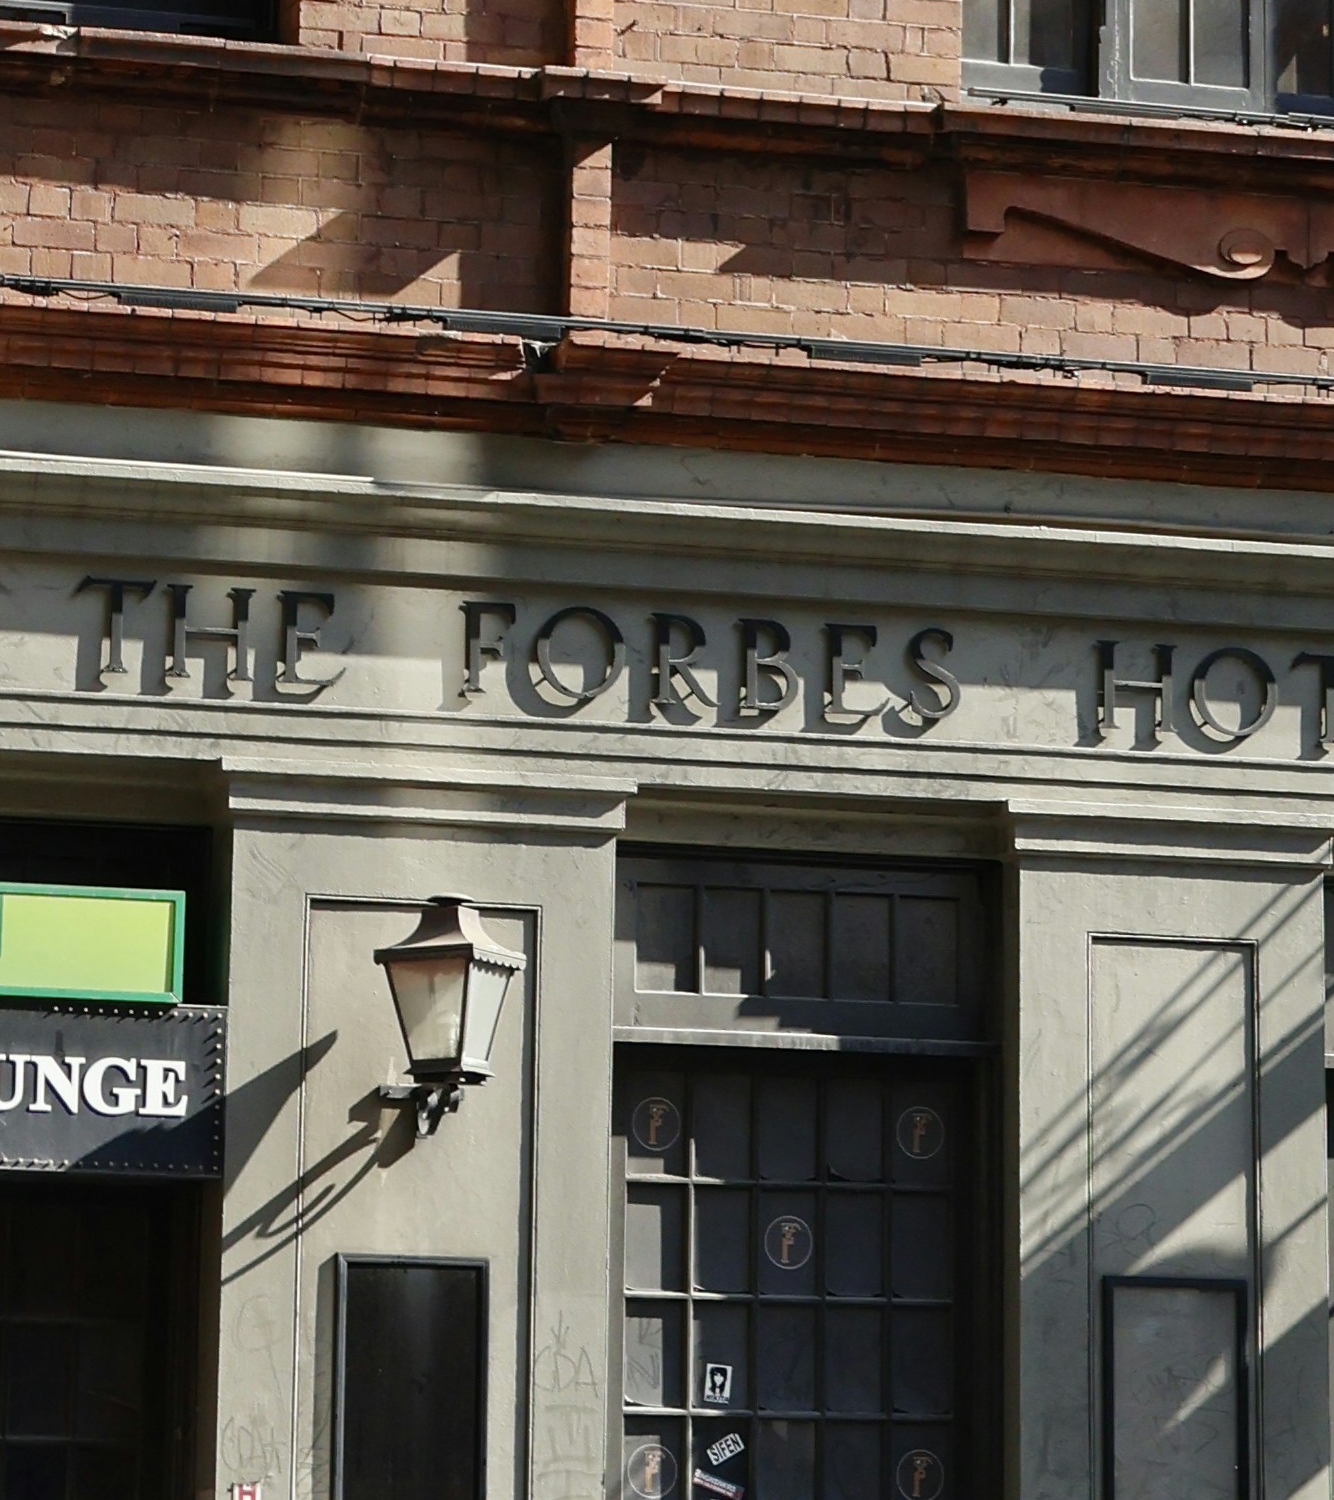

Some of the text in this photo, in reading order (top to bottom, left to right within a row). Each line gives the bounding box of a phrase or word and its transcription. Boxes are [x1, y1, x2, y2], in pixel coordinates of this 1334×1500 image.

[76, 575, 348, 688] THE
[457, 601, 960, 720] FORBES
[707, 1433, 744, 1466] SIFEN
